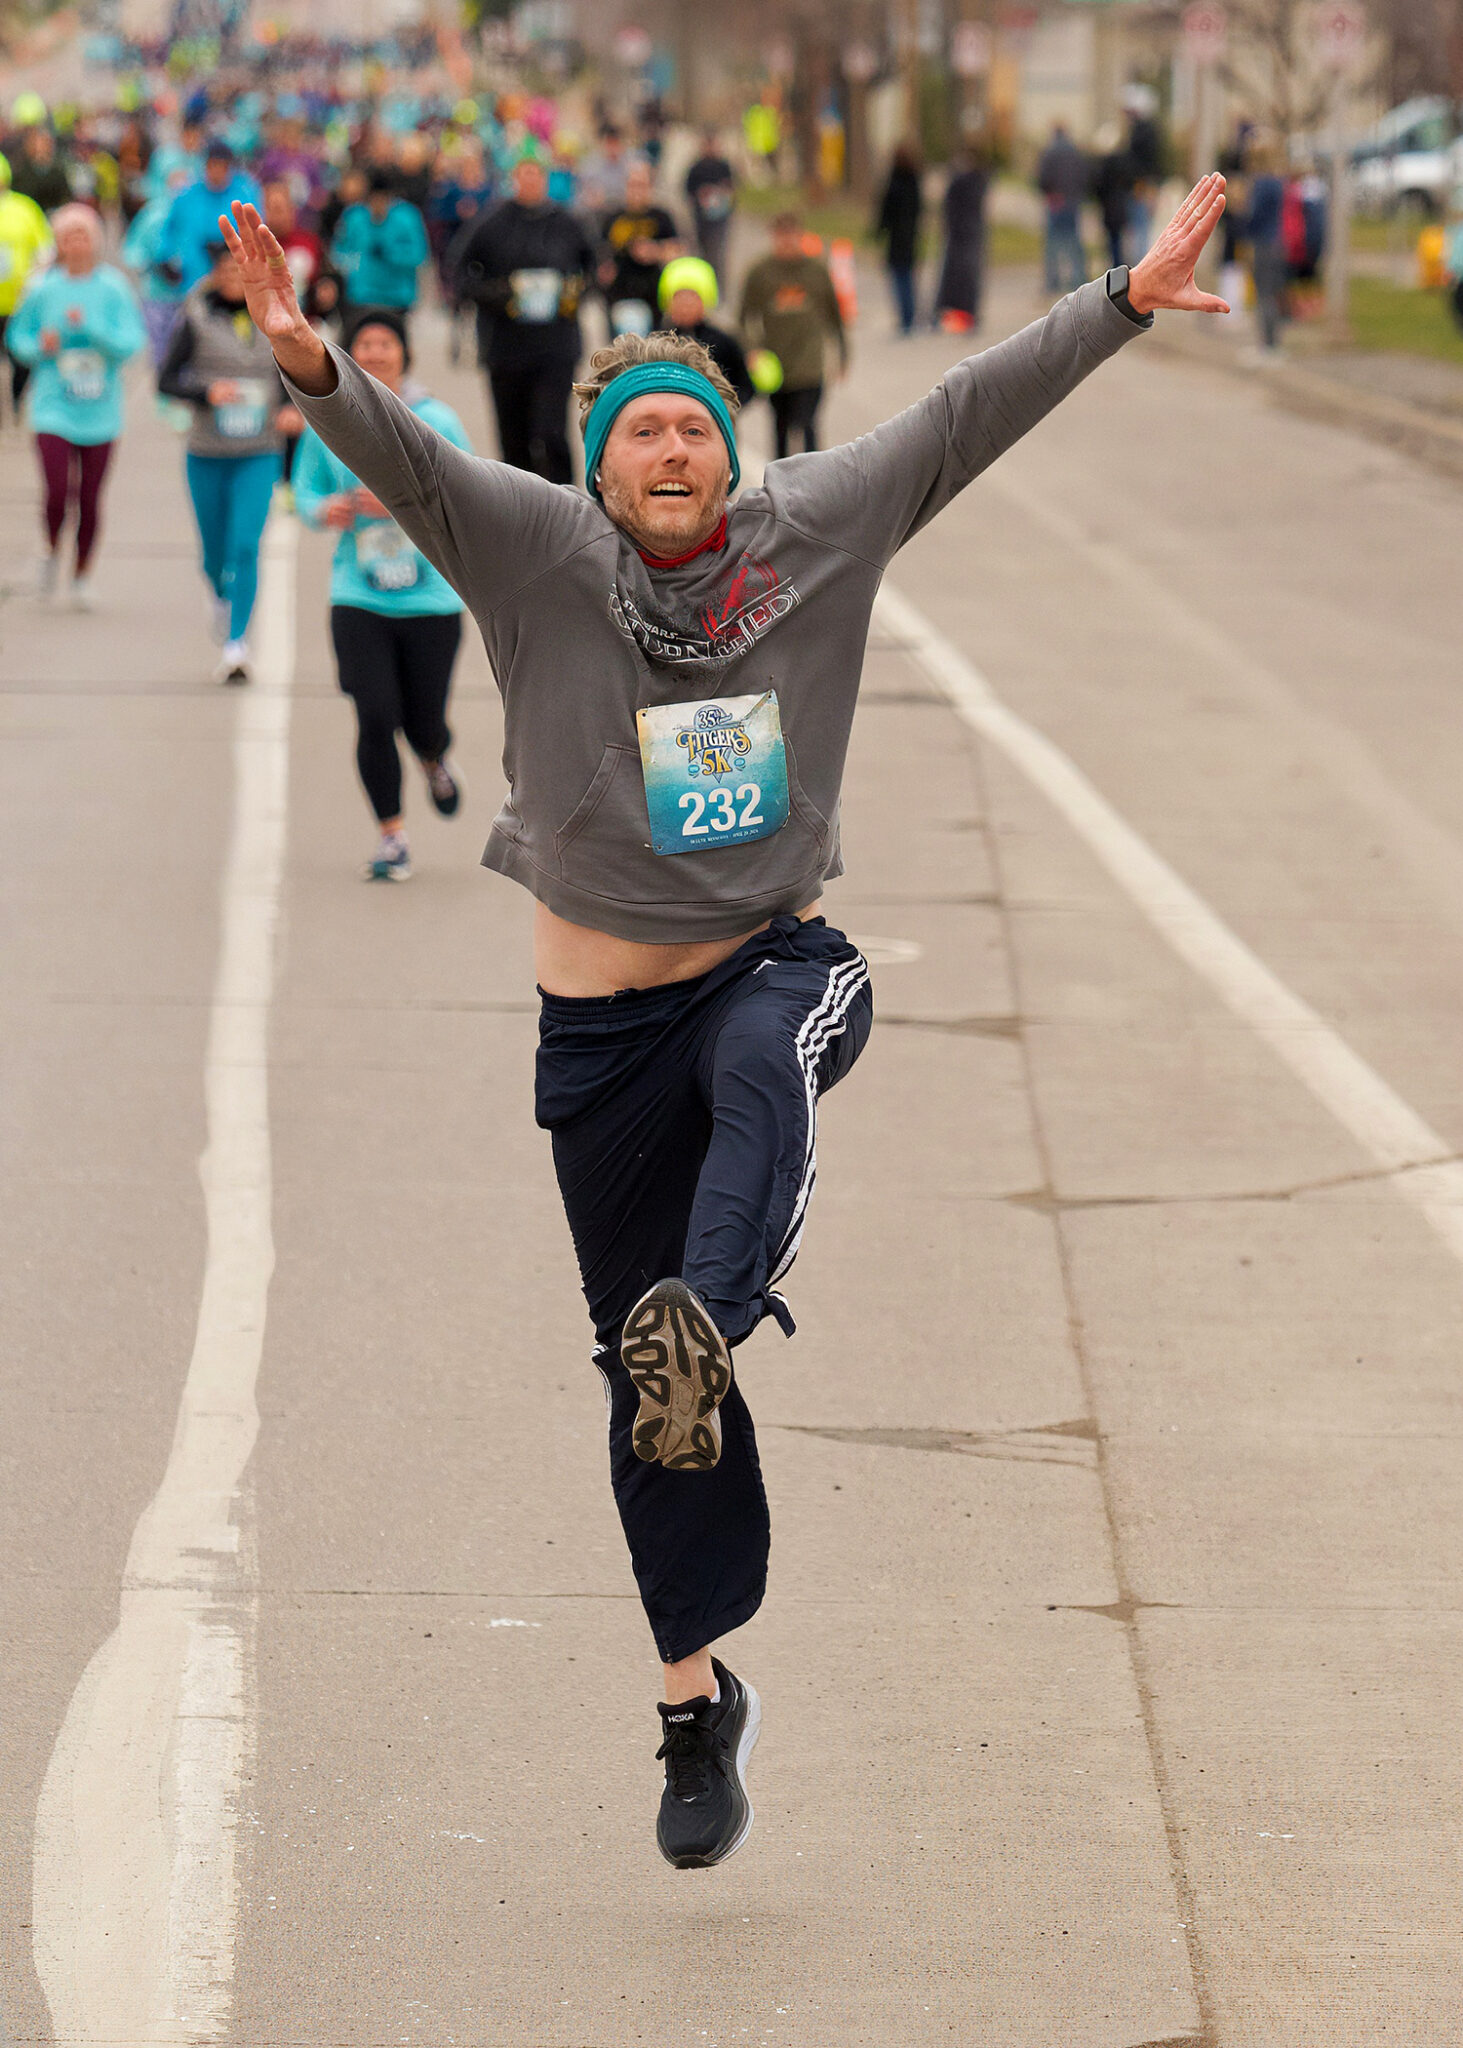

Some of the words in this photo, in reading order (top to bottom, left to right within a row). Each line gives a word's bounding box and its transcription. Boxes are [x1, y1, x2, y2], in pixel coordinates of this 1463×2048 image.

[736, 585, 802, 648] JEDI
[701, 748, 733, 776] 5K
[678, 783, 764, 836] 232
[667, 1712, 695, 1723] HOKA
